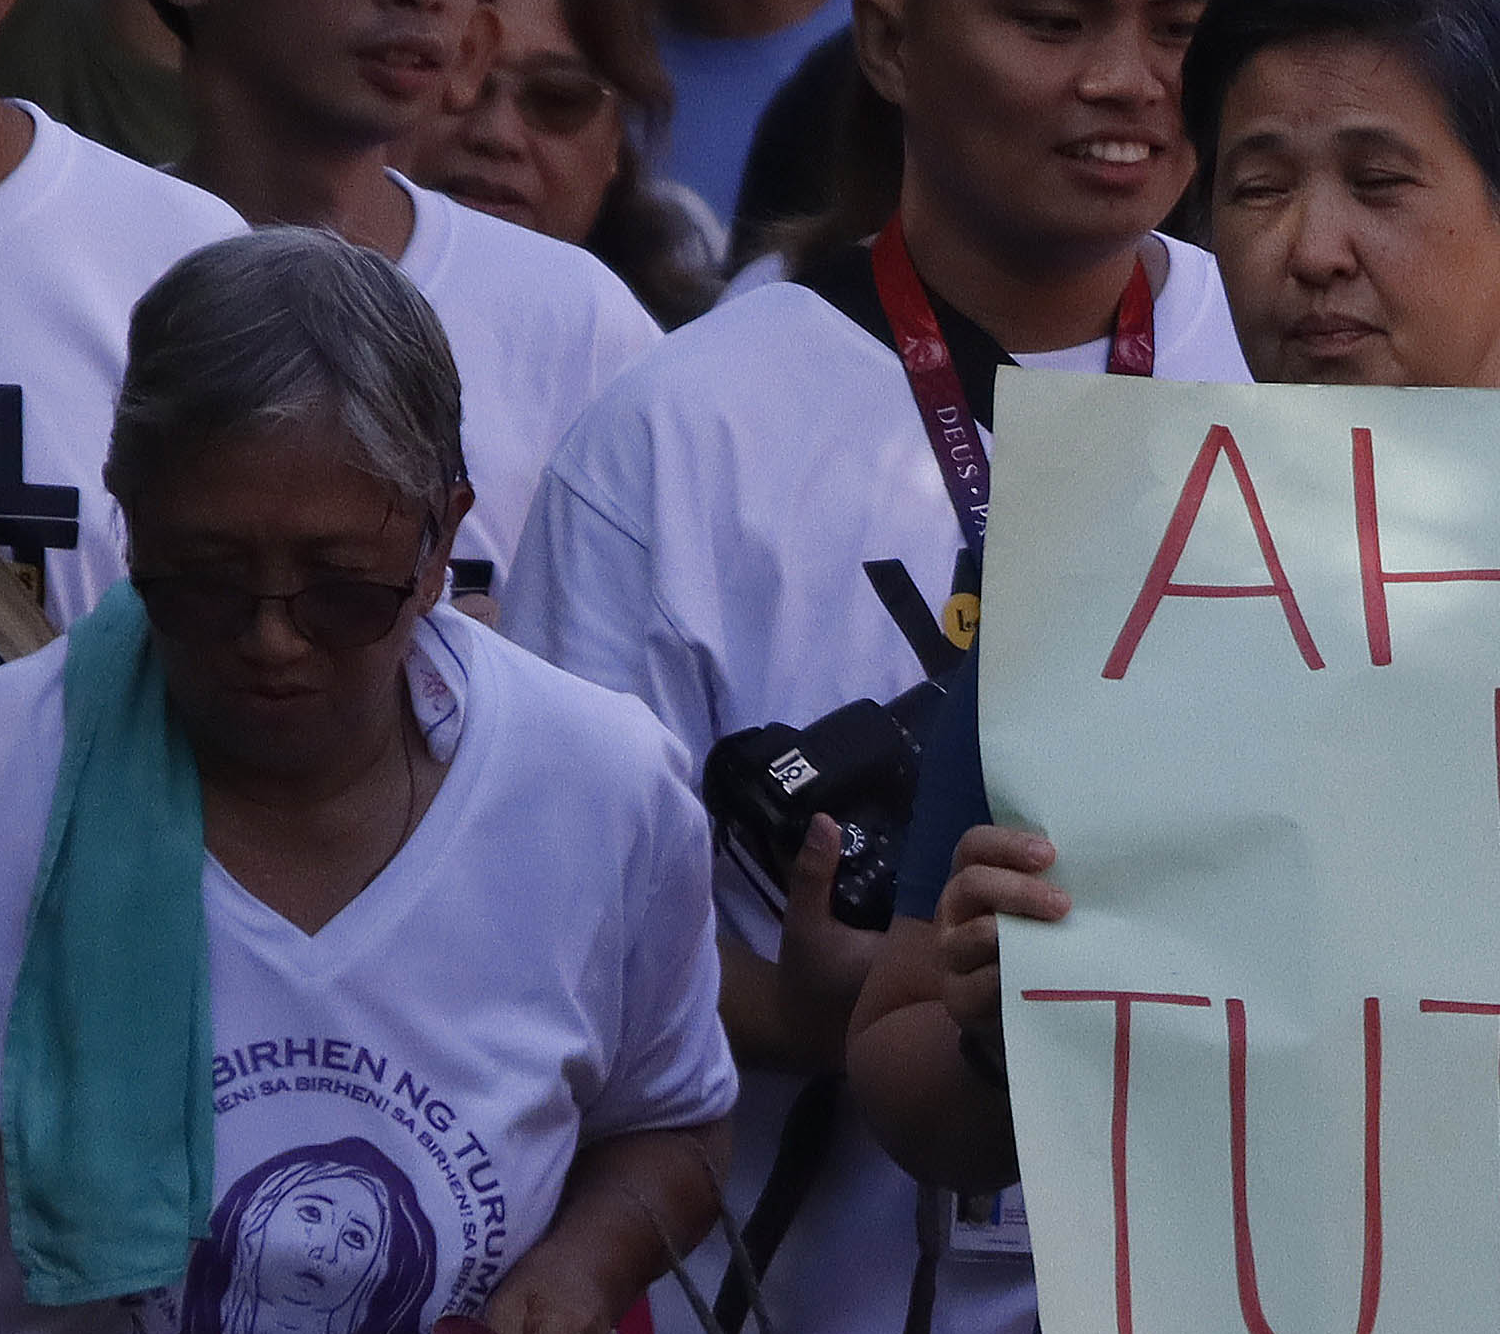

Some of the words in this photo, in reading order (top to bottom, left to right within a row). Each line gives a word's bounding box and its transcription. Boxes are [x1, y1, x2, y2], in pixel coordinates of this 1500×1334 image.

[936, 405, 979, 484] DEUS
[211, 1037, 388, 1091] BIRHEN
[393, 1071, 457, 1133] NG
[261, 1077, 292, 1097] SA
[295, 1075, 389, 1113] BIRHEN!
[390, 1106, 416, 1134] SA
